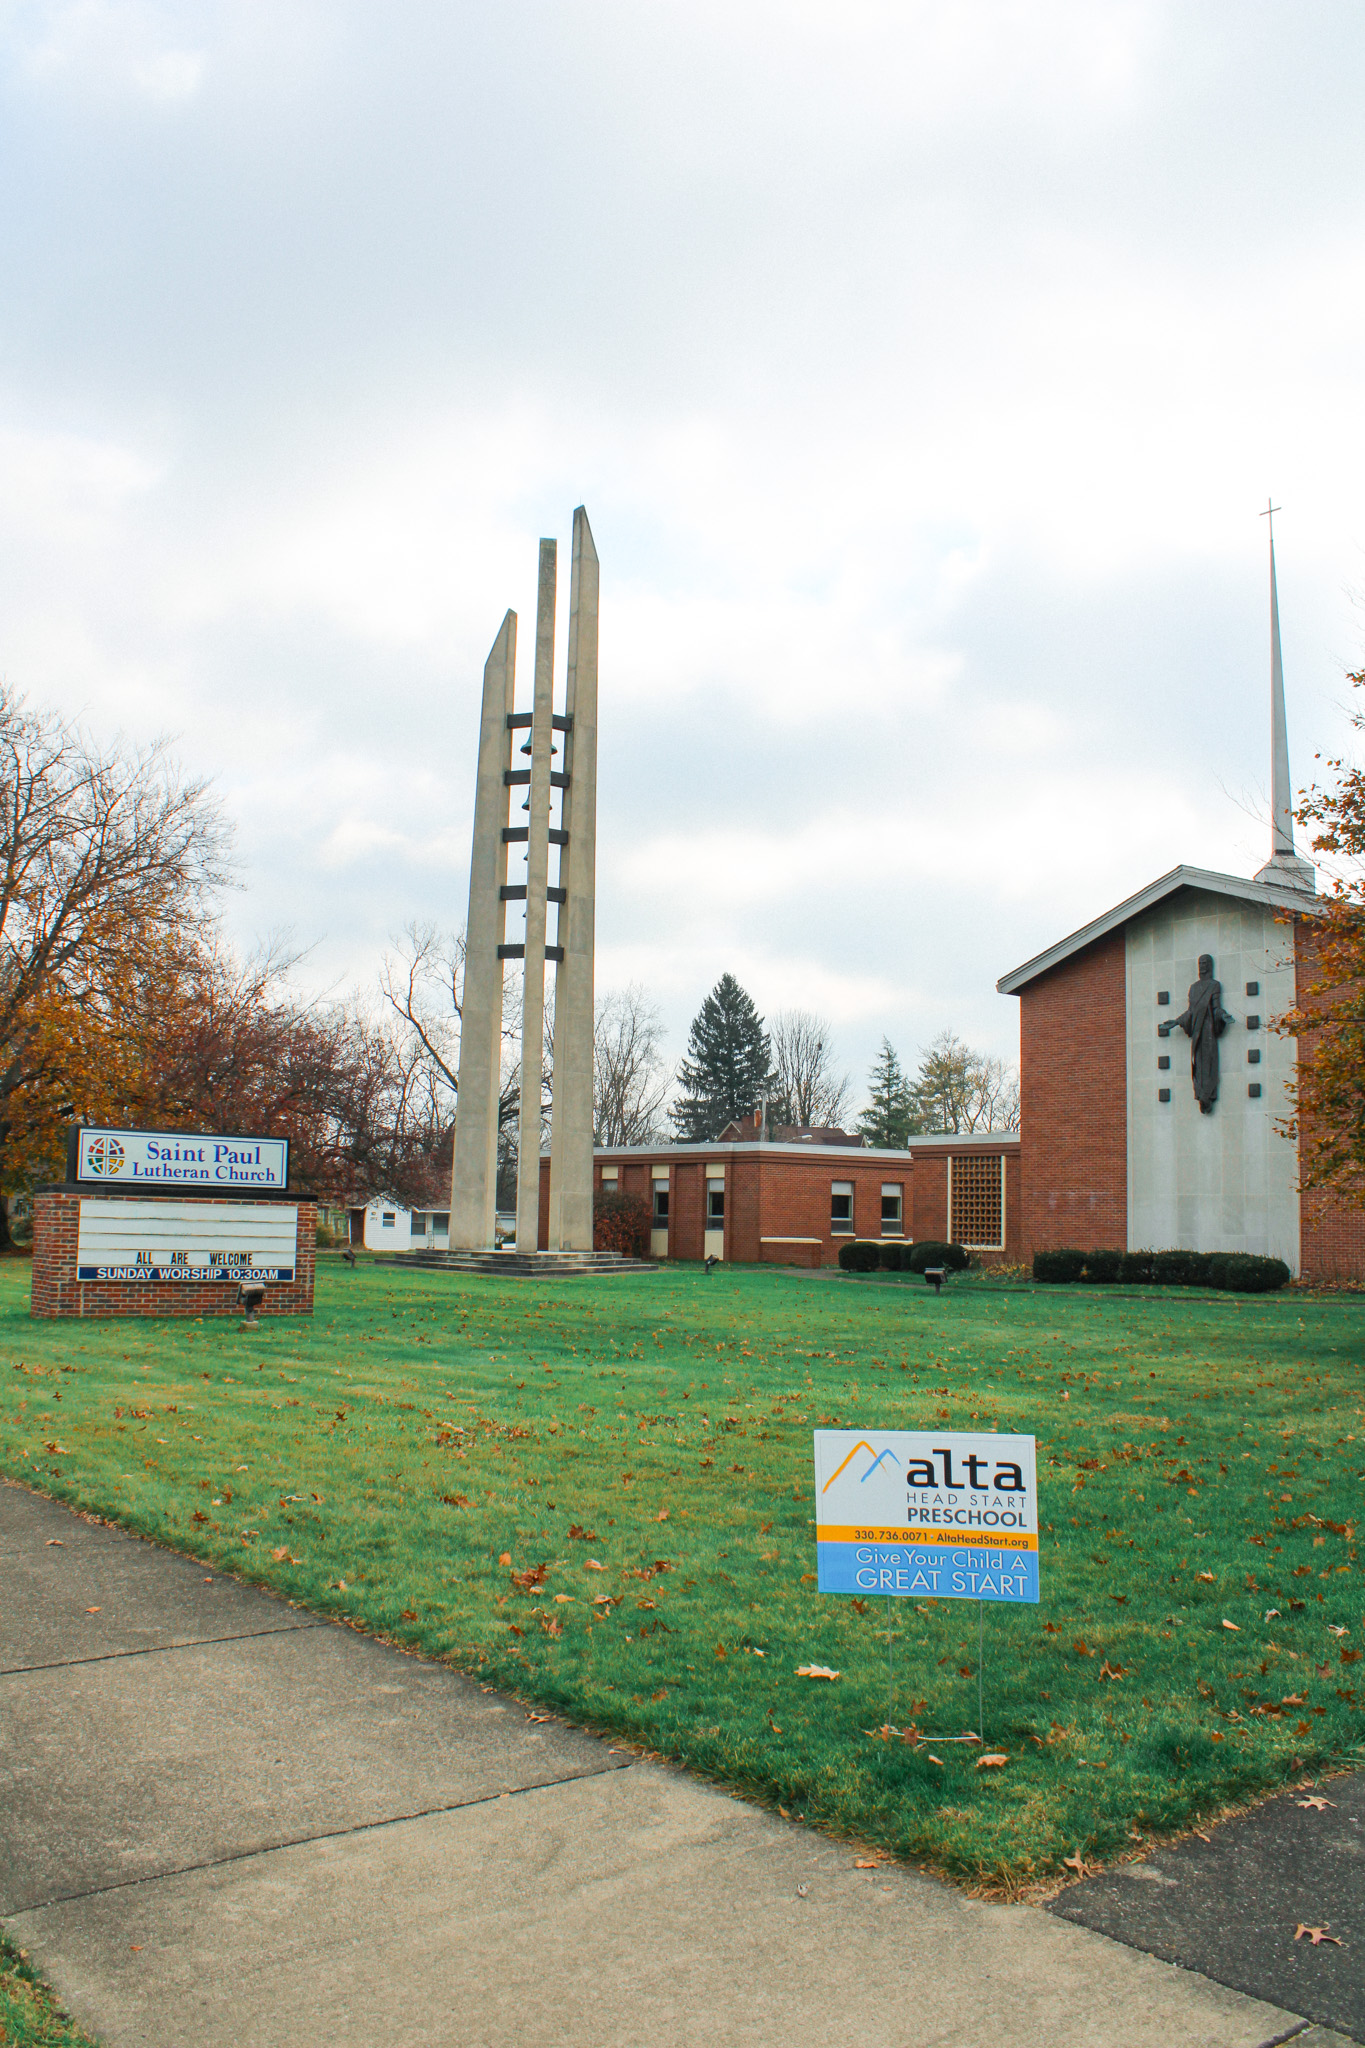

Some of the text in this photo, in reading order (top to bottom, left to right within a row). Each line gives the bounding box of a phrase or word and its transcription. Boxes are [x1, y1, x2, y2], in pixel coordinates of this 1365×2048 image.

[146, 1140, 262, 1165] Saint Paul
[132, 1162, 276, 1182] Lutheran Church
[136, 1251, 253, 1265] ALL ARE WELCOME
[96, 1267, 279, 1280] SUNDAY WORSHIP 10:30AM
[906, 1448, 1026, 1492] alta
[906, 1492, 1027, 1508] HEAD START
[907, 1507, 1028, 1528] PRESCHOOL
[854, 1530, 1029, 1549] 330.736.0071 AltaHeadStart.org
[855, 1547, 1028, 1571] Give Your Child A
[855, 1567, 1029, 1596] GREAT START
